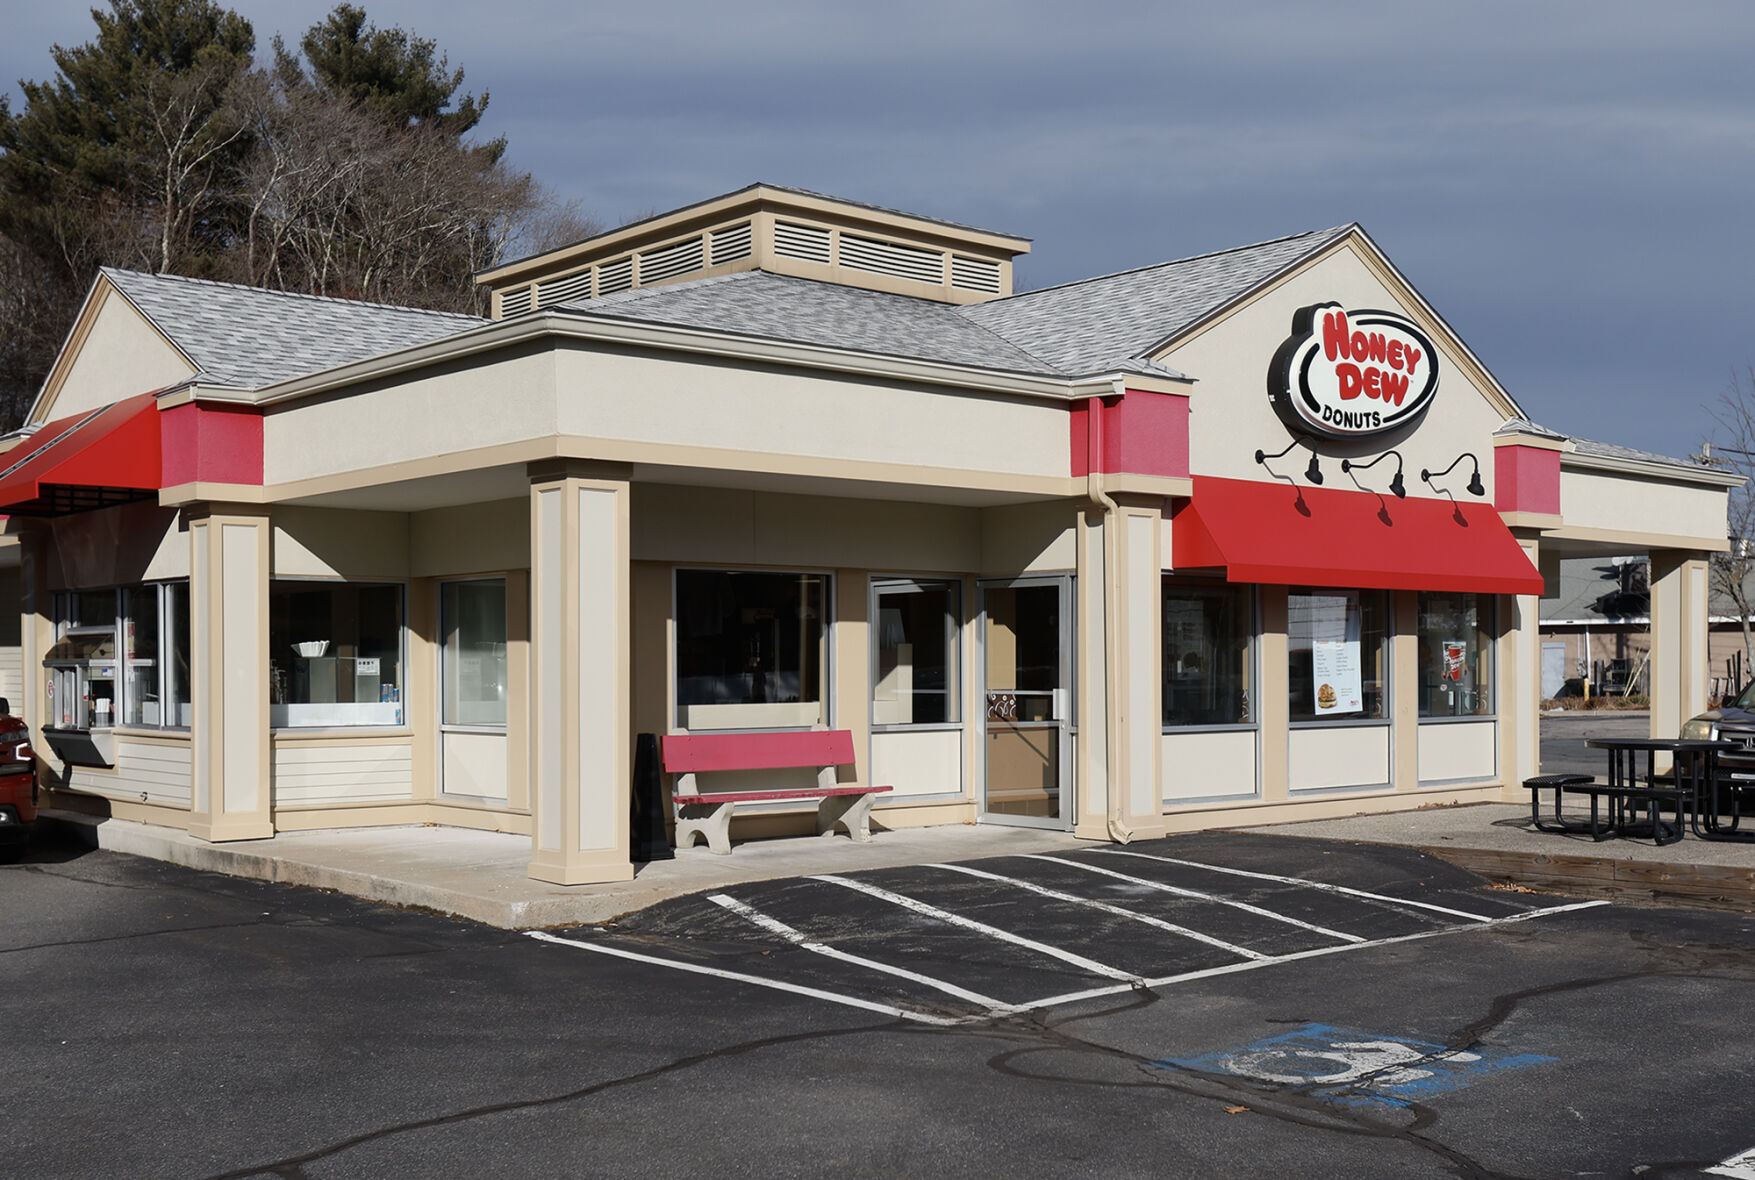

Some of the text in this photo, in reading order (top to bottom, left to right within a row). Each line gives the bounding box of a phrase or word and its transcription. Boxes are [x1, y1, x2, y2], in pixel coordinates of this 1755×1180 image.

[1323, 311, 1421, 375] HONEY
[1335, 363, 1409, 406] DEW
[1322, 405, 1381, 428] DONUTS
